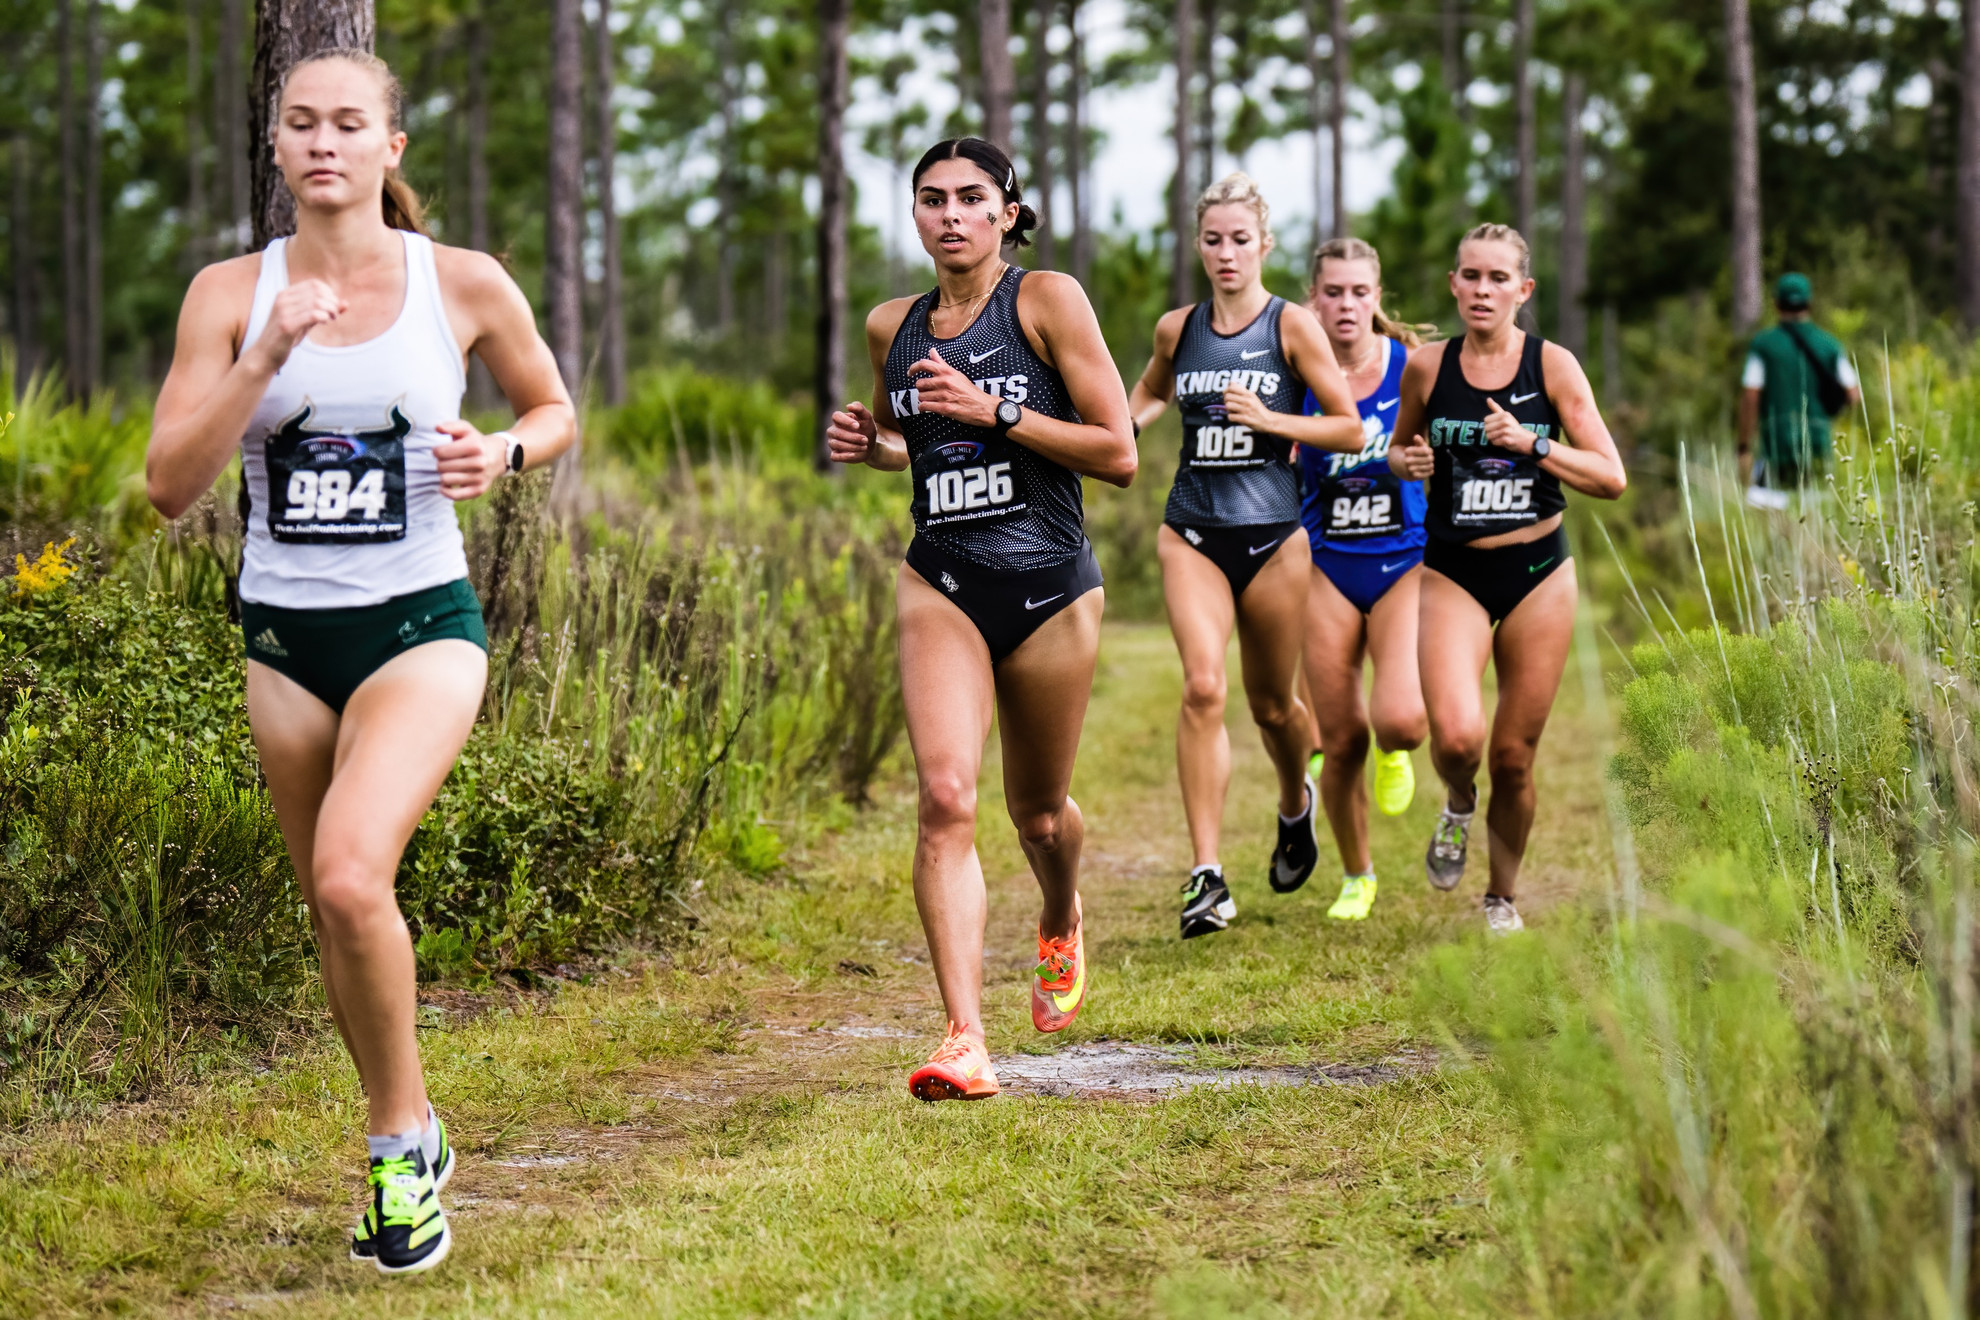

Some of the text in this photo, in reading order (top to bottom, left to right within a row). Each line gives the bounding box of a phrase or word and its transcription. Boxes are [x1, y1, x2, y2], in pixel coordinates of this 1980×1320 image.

[1176, 369, 1281, 397] KNIGHTS
[1196, 425, 1254, 458] 1015
[284, 469, 387, 520] 984
[925, 461, 1013, 515] 1026
[1461, 478, 1534, 512] 1005
[926, 502, 1027, 527] live.halfmiletiming.com
[1331, 494, 1391, 527] 942
